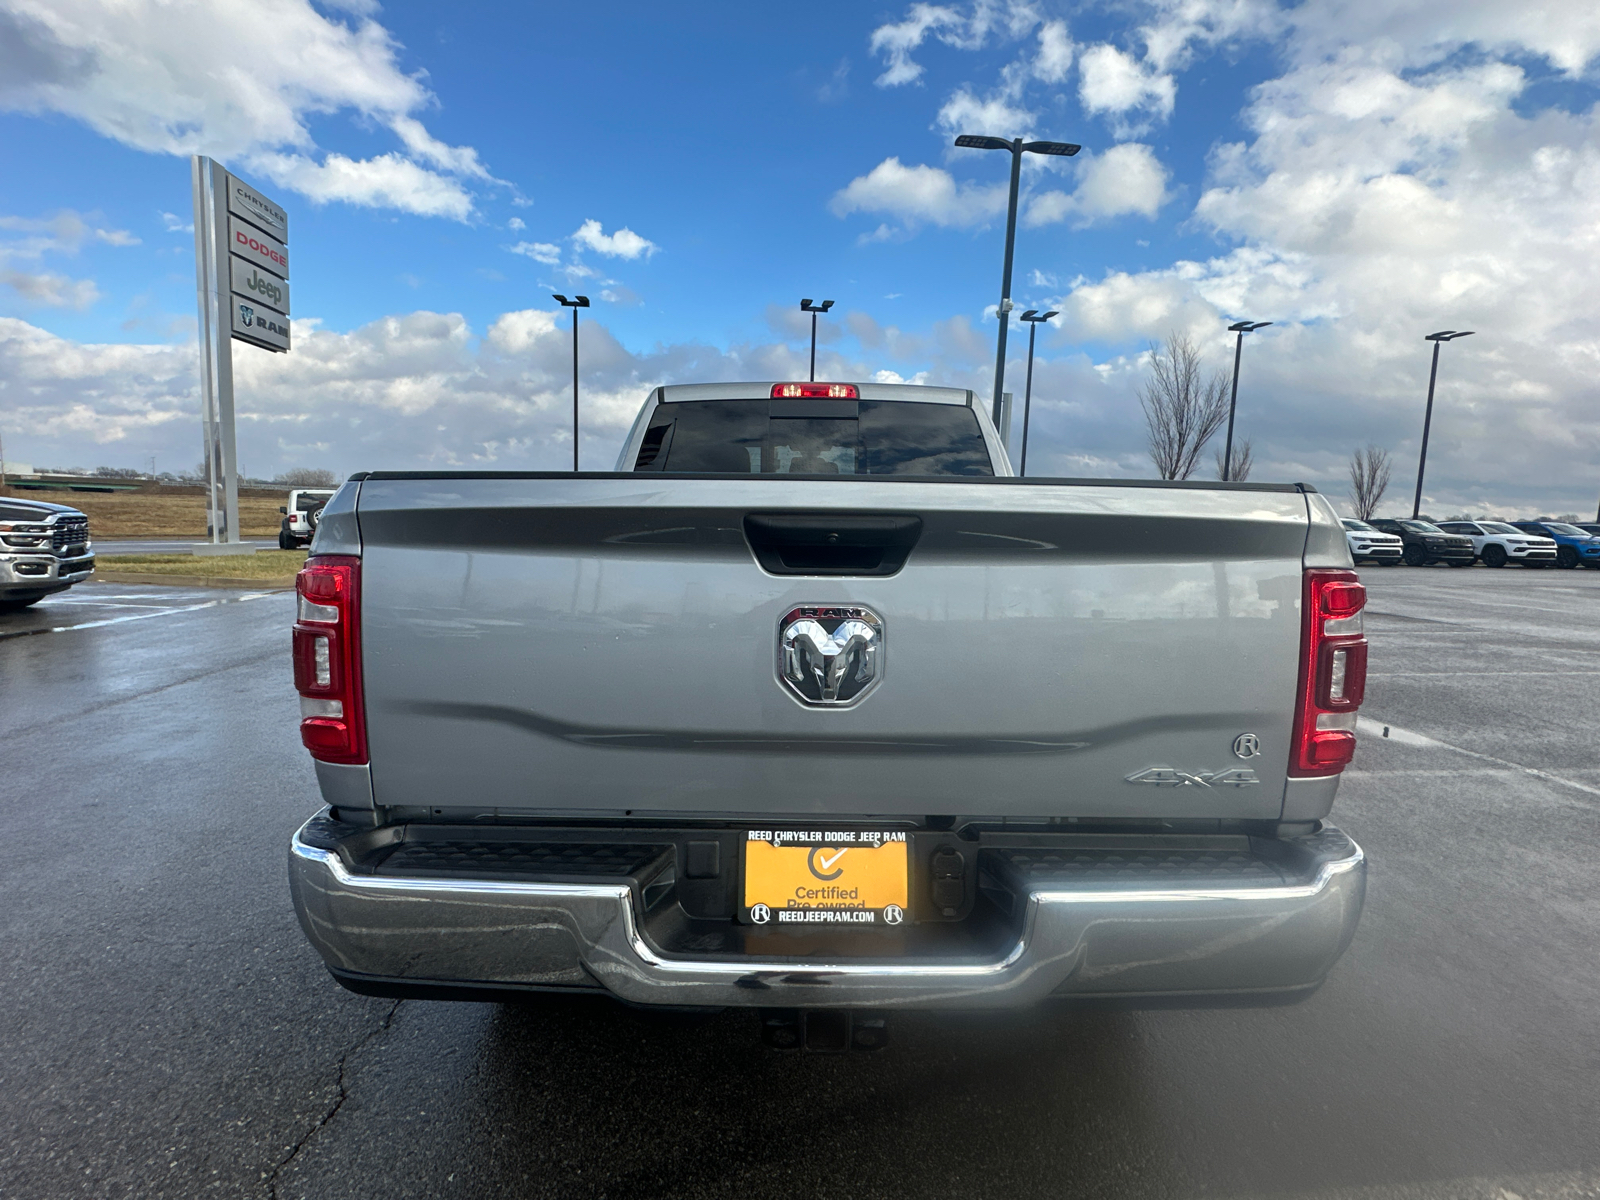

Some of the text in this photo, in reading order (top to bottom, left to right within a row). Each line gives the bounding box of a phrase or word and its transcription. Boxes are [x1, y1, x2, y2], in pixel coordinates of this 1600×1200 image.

[236, 188, 285, 223] CHRYSLER
[236, 231, 287, 267] DODGE
[247, 270, 282, 305] Jeep
[256, 315, 289, 338] RAM
[800, 608, 862, 618] RAM
[748, 830, 906, 842] REED CHRYSLER DODGE JEEP RAM
[795, 886, 858, 899] Certified
[779, 911, 874, 922] REEDJEEPRAM.COM
